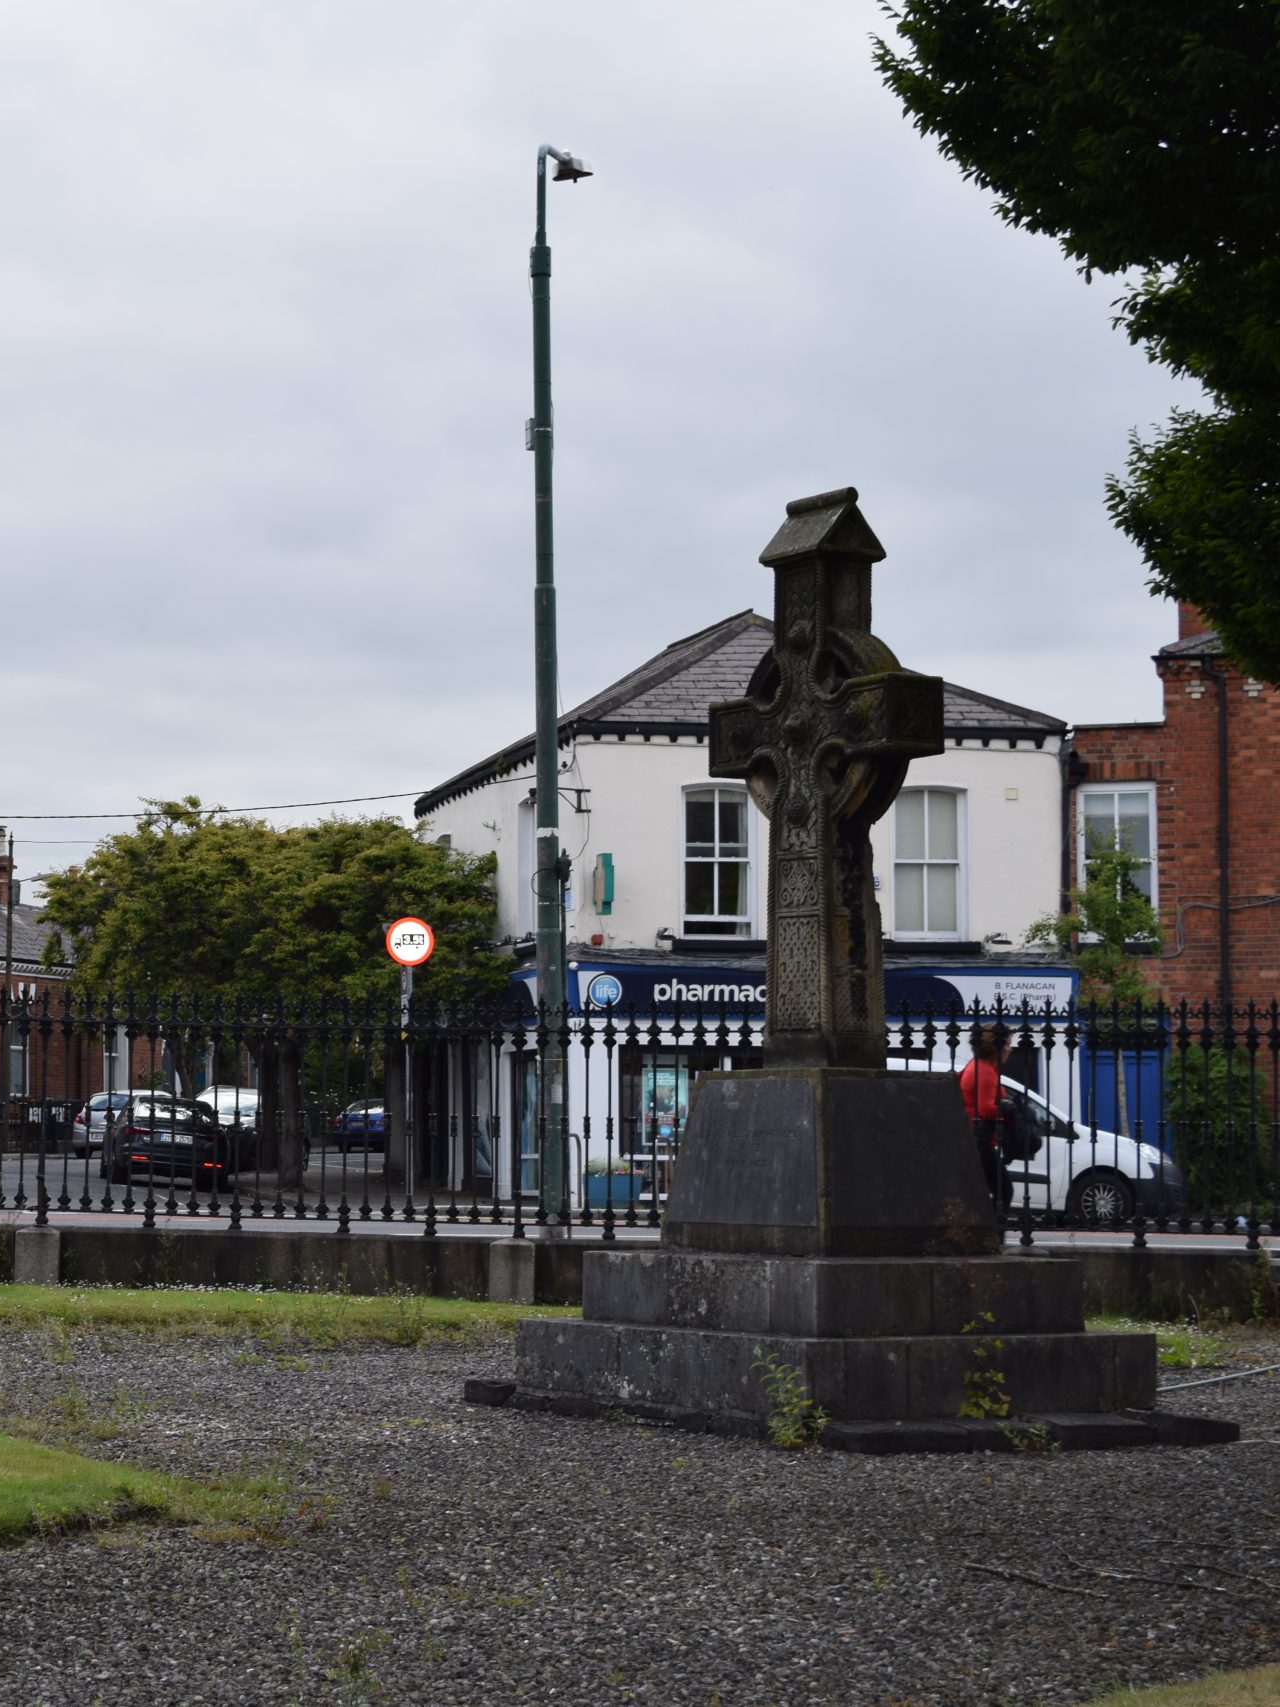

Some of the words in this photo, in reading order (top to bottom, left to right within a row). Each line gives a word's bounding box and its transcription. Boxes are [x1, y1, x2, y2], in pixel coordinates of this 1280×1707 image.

[595, 984, 618, 998] life
[654, 978, 767, 1004] pharmac
[1005, 982, 1056, 990] FLANAGAN
